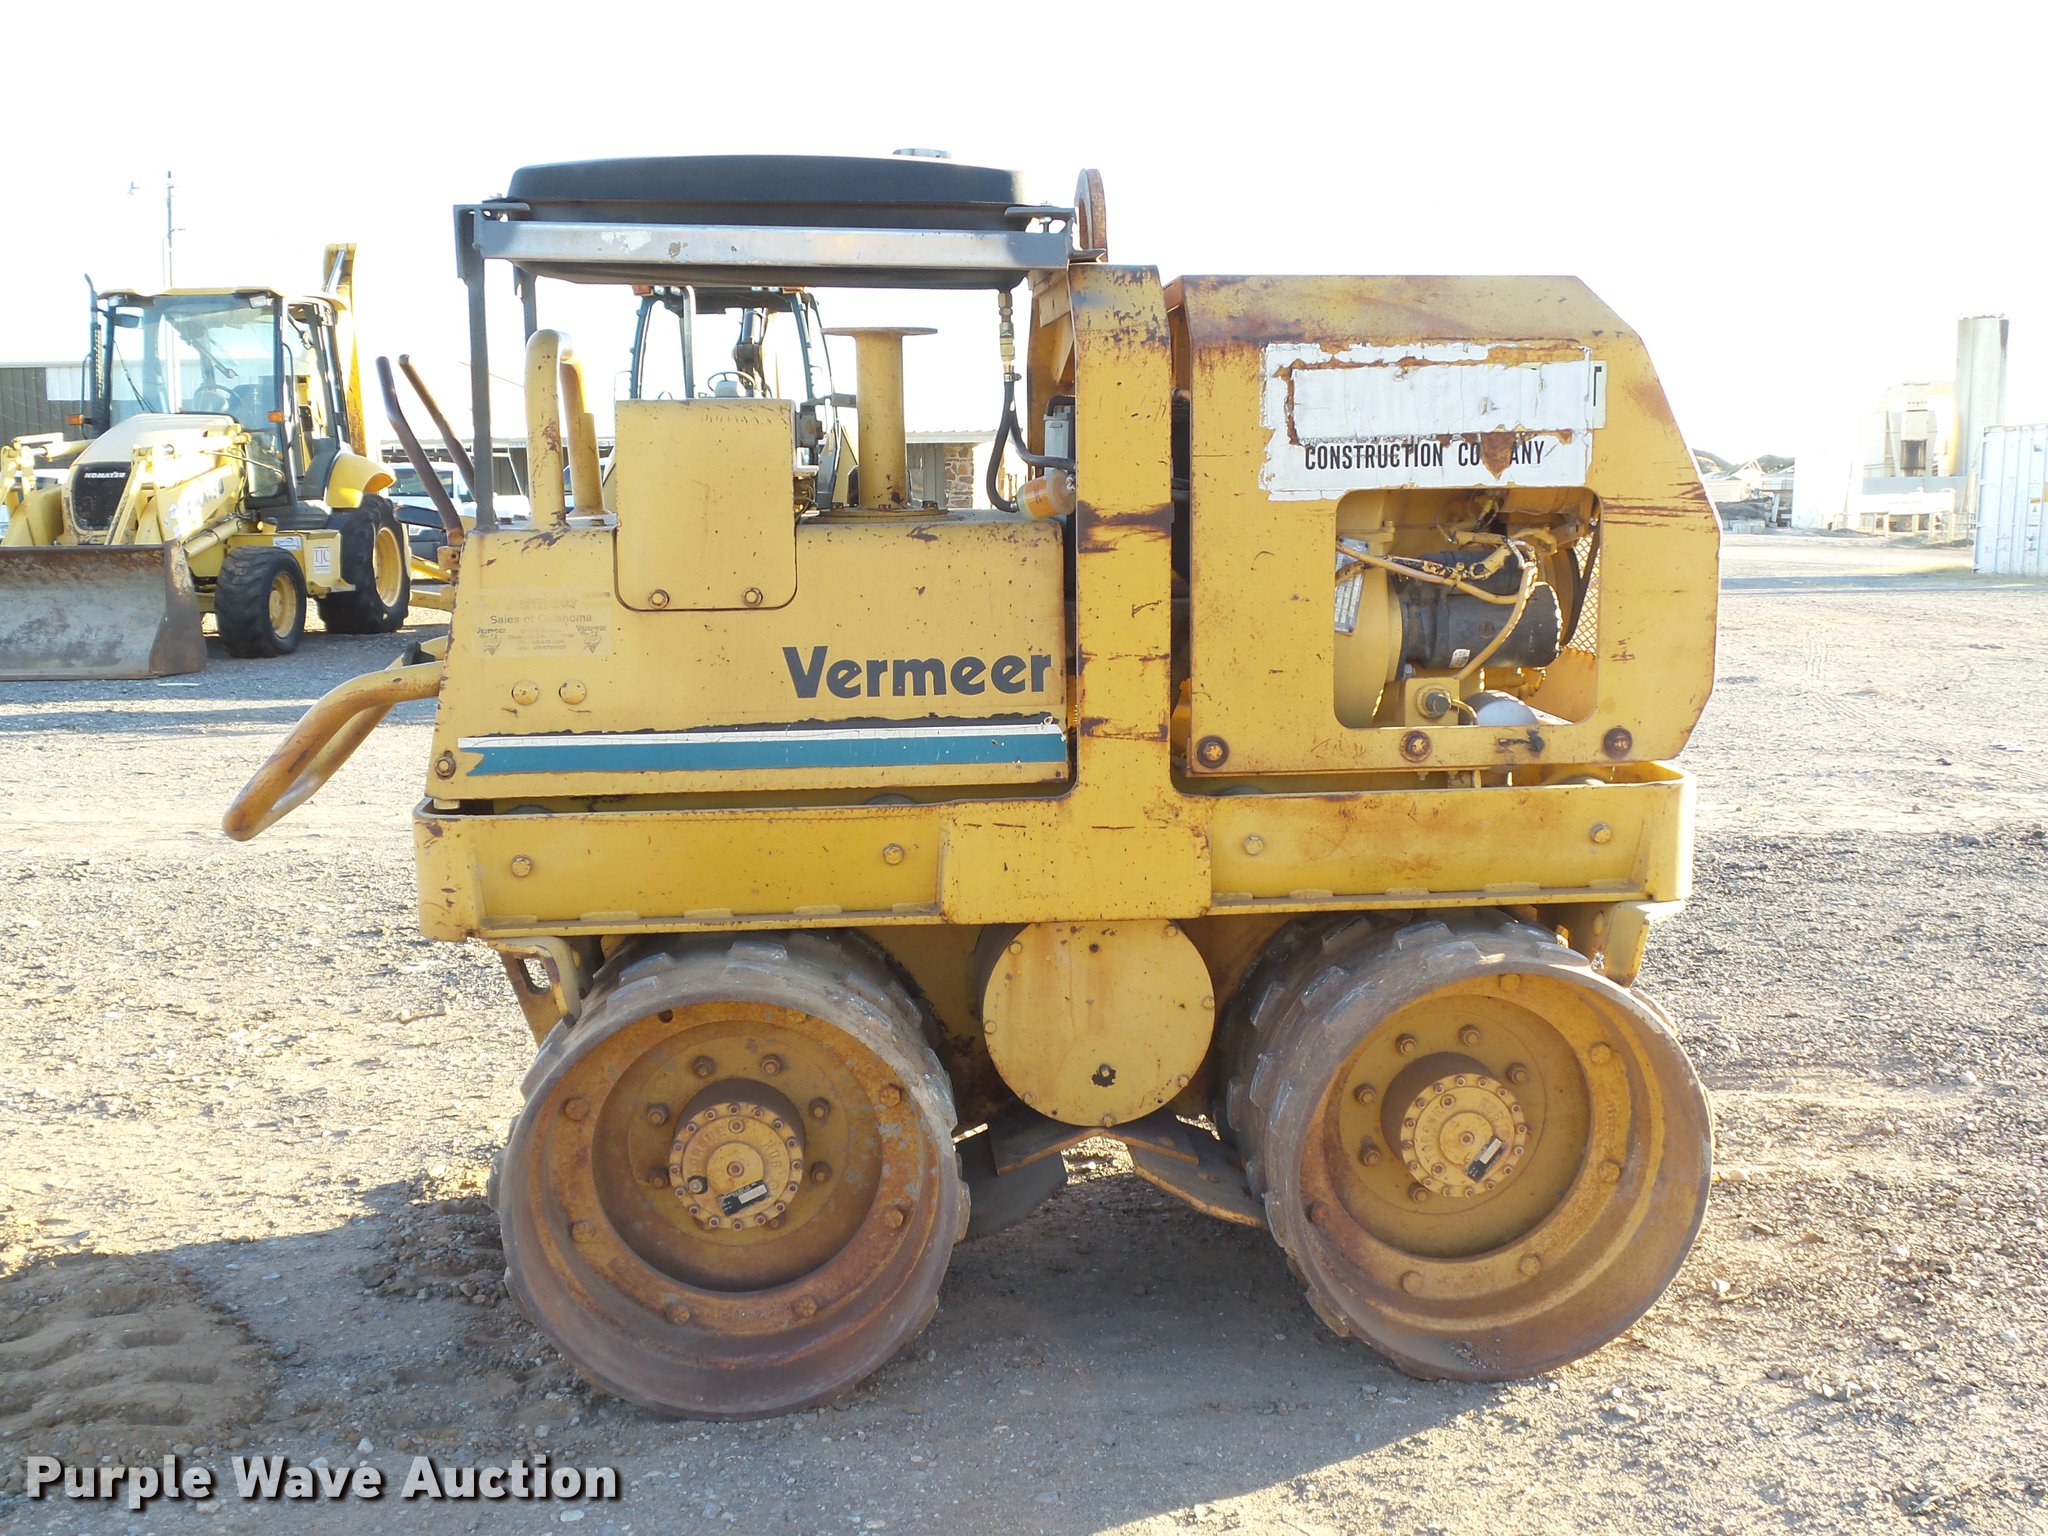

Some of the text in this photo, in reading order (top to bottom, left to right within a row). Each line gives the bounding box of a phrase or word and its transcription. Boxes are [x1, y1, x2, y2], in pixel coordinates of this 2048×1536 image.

[1305, 440, 1545, 470] CONSTRUCTION COANY
[84, 471, 126, 479] KOMATSU
[313, 549, 330, 564] TJC
[490, 615, 519, 624] Sales
[782, 645, 1051, 698] Vermeer
